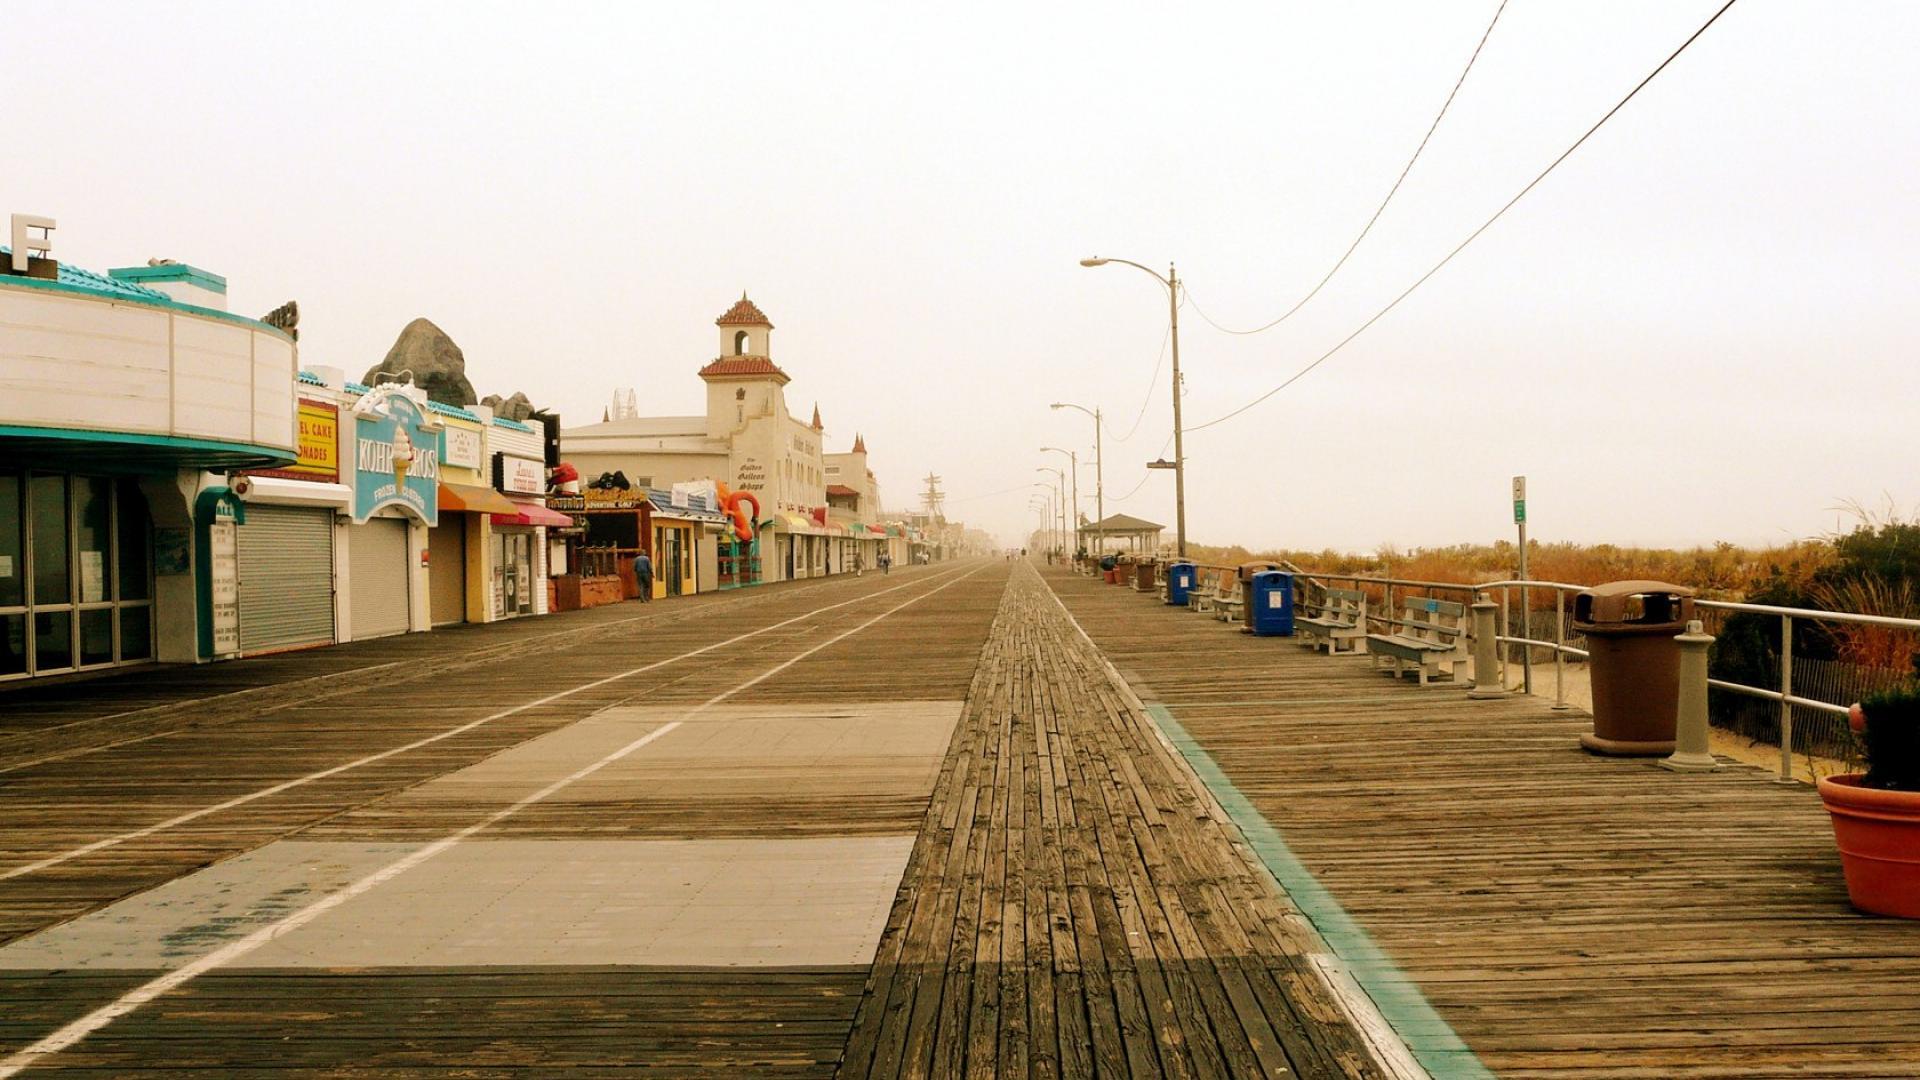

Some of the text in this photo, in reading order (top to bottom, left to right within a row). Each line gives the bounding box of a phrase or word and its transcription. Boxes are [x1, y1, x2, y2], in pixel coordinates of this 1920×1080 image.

[10, 213, 57, 272] F
[312, 423, 332, 438] CAKE
[358, 438, 394, 474] KOHR
